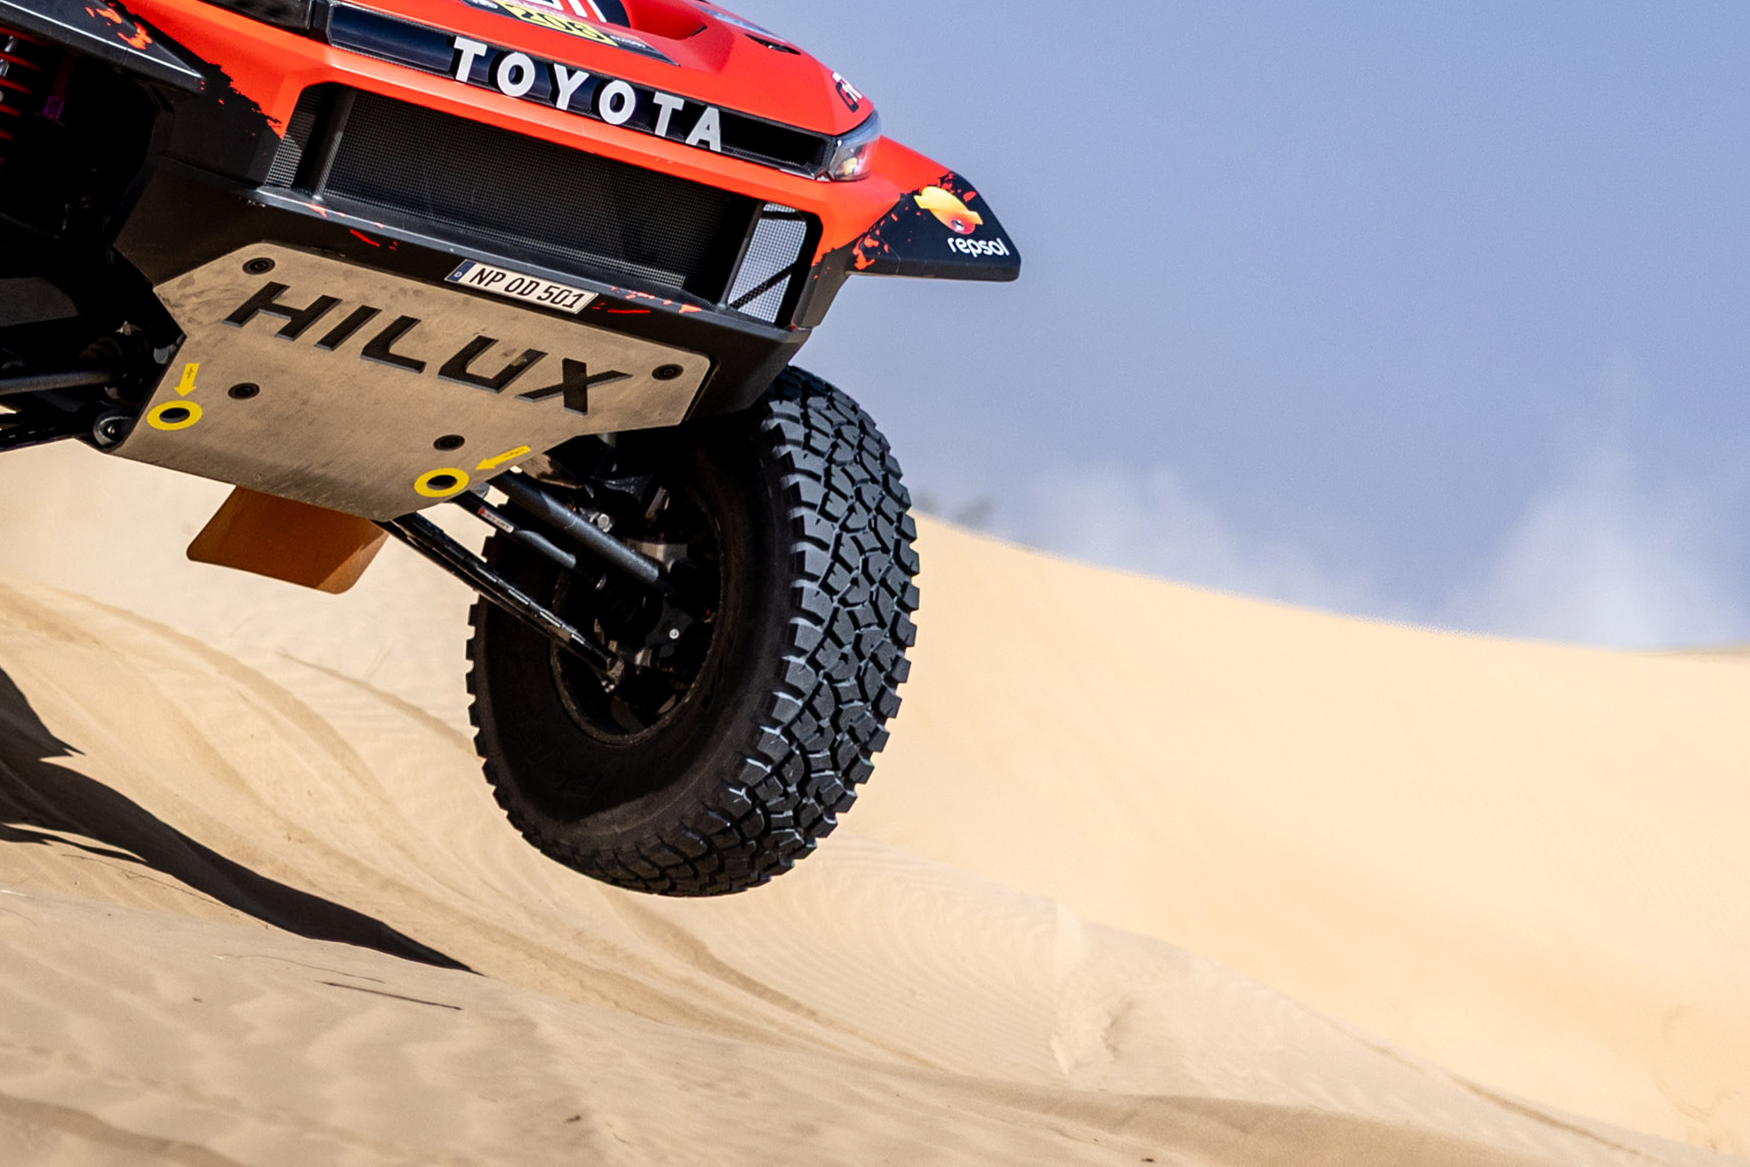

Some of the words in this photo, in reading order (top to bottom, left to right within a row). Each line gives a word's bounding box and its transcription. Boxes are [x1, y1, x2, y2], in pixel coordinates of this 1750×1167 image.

[452, 37, 724, 152] TOYOTA
[947, 237, 1010, 258] repsol
[469, 267, 507, 287] NP
[504, 277, 540, 296] OD
[536, 285, 586, 309] 501
[223, 280, 633, 416] HILUX
